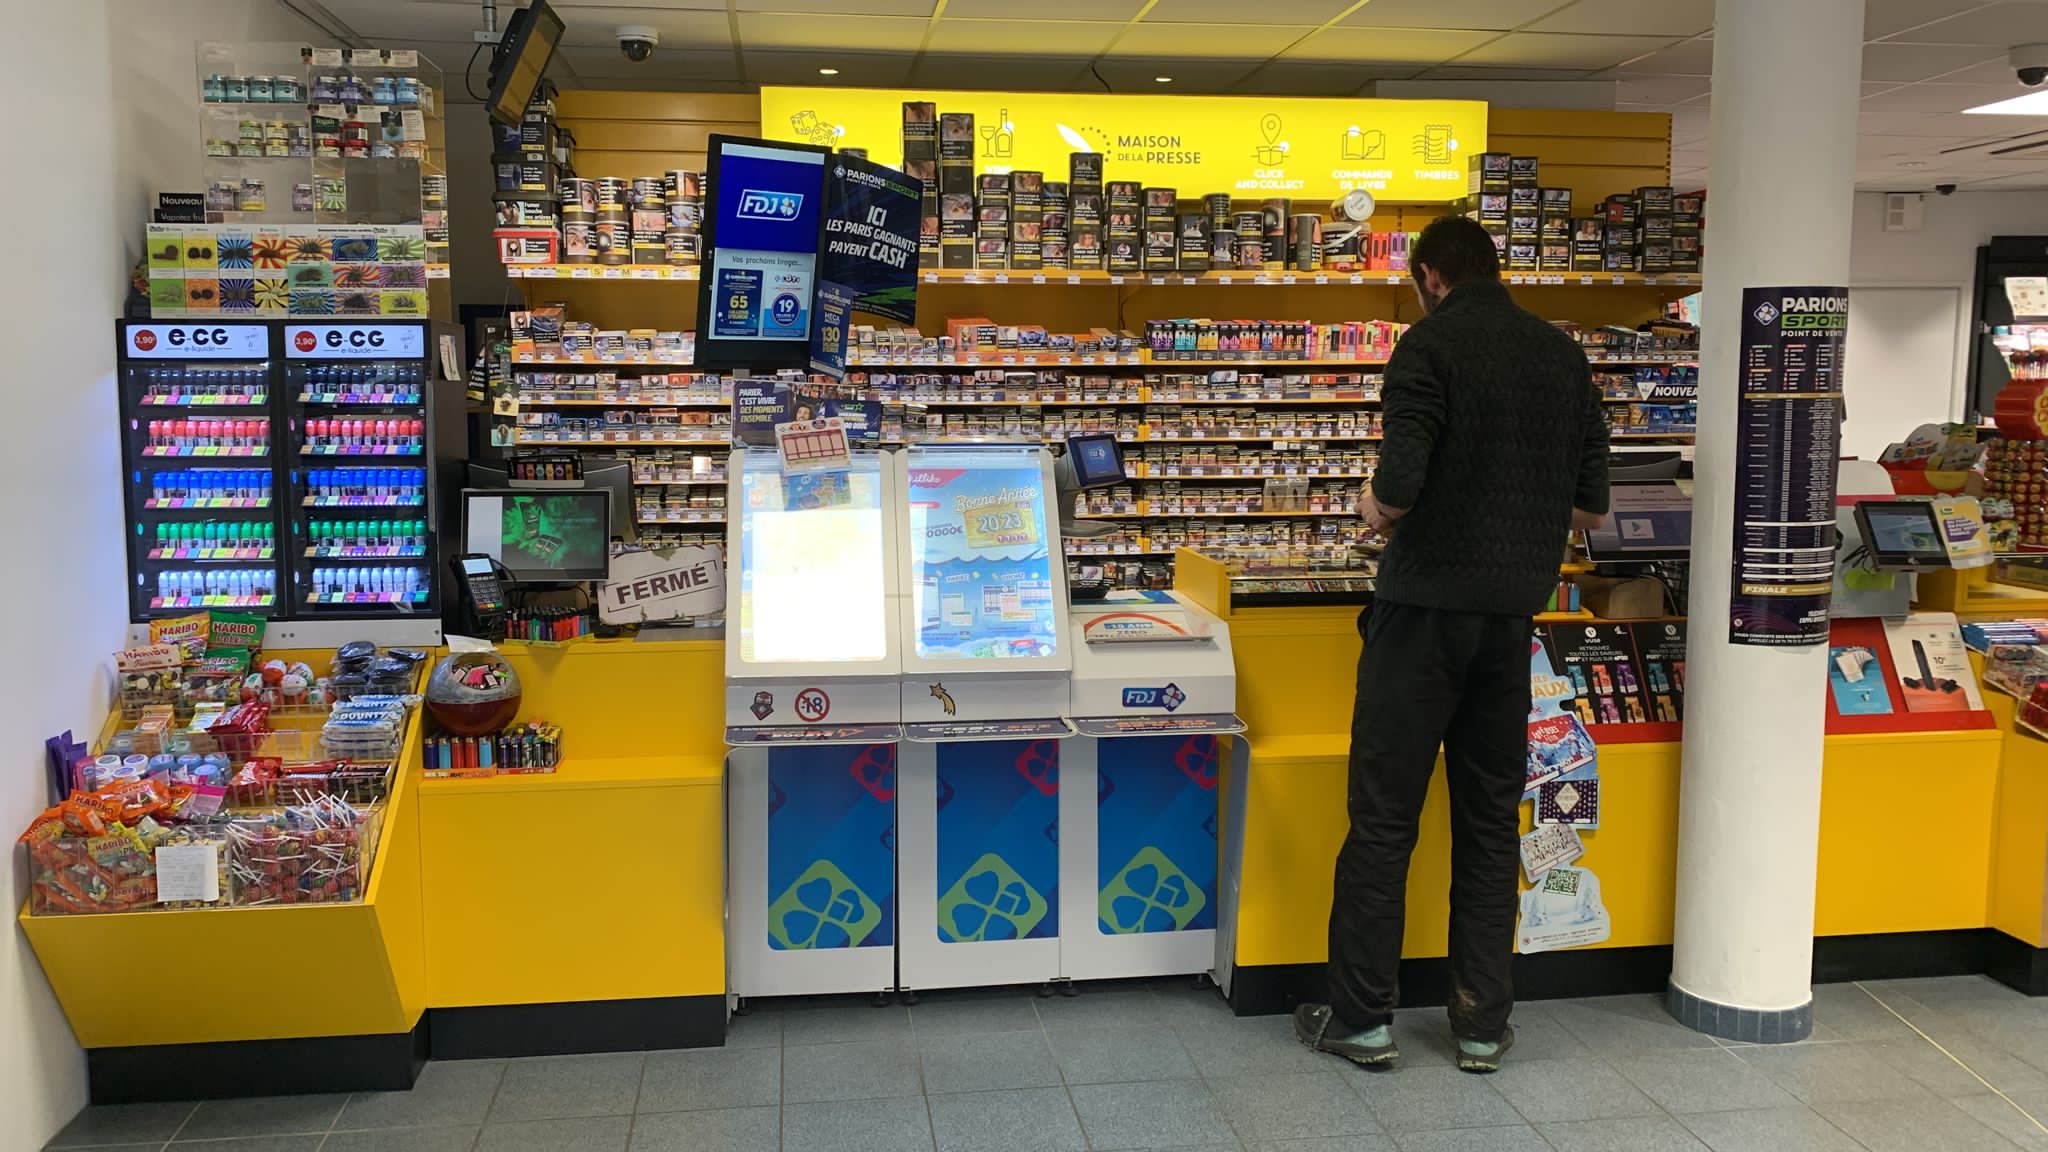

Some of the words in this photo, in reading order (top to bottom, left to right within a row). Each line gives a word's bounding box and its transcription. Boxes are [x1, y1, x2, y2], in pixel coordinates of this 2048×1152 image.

[1117, 135, 1181, 148] MAISON
[1117, 153, 1128, 161] DE
[1131, 153, 1143, 161] LA
[1146, 152, 1201, 164] PRESSE
[847, 169, 886, 187] PARIONS
[1253, 169, 1284, 179] CLICK
[1331, 170, 1392, 179] COMMANDE
[1414, 170, 1460, 180] TIMBRES
[1236, 180, 1257, 189] AND
[1259, 180, 1304, 189] COLLECT
[1340, 180, 1353, 189] DE
[1357, 180, 1386, 189] LIVRE
[161, 197, 203, 205] Nouveau
[742, 195, 779, 215] FDJ
[866, 205, 888, 227] ICI
[826, 218, 844, 232] LES
[843, 221, 873, 238] PARIS
[873, 228, 917, 253] GAGNANTS
[828, 240, 869, 257] PAYENT
[732, 256, 743, 264] Vos
[729, 295, 748, 309] 65
[778, 299, 795, 313] 19
[1781, 297, 1848, 313] PARIONS
[1784, 315, 1846, 328] SPORT
[821, 327, 840, 343] 130
[740, 405, 753, 413] DES
[955, 494, 997, 513] Bonne
[616, 563, 709, 605] FERMÉ
[1744, 586, 1788, 594] FINALE
[160, 622, 199, 636] HARIBO
[213, 622, 257, 634] HARIBO
[1126, 690, 1157, 704] FDJ
[801, 696, 823, 714] -18
[340, 711, 387, 720] BOUNTY
